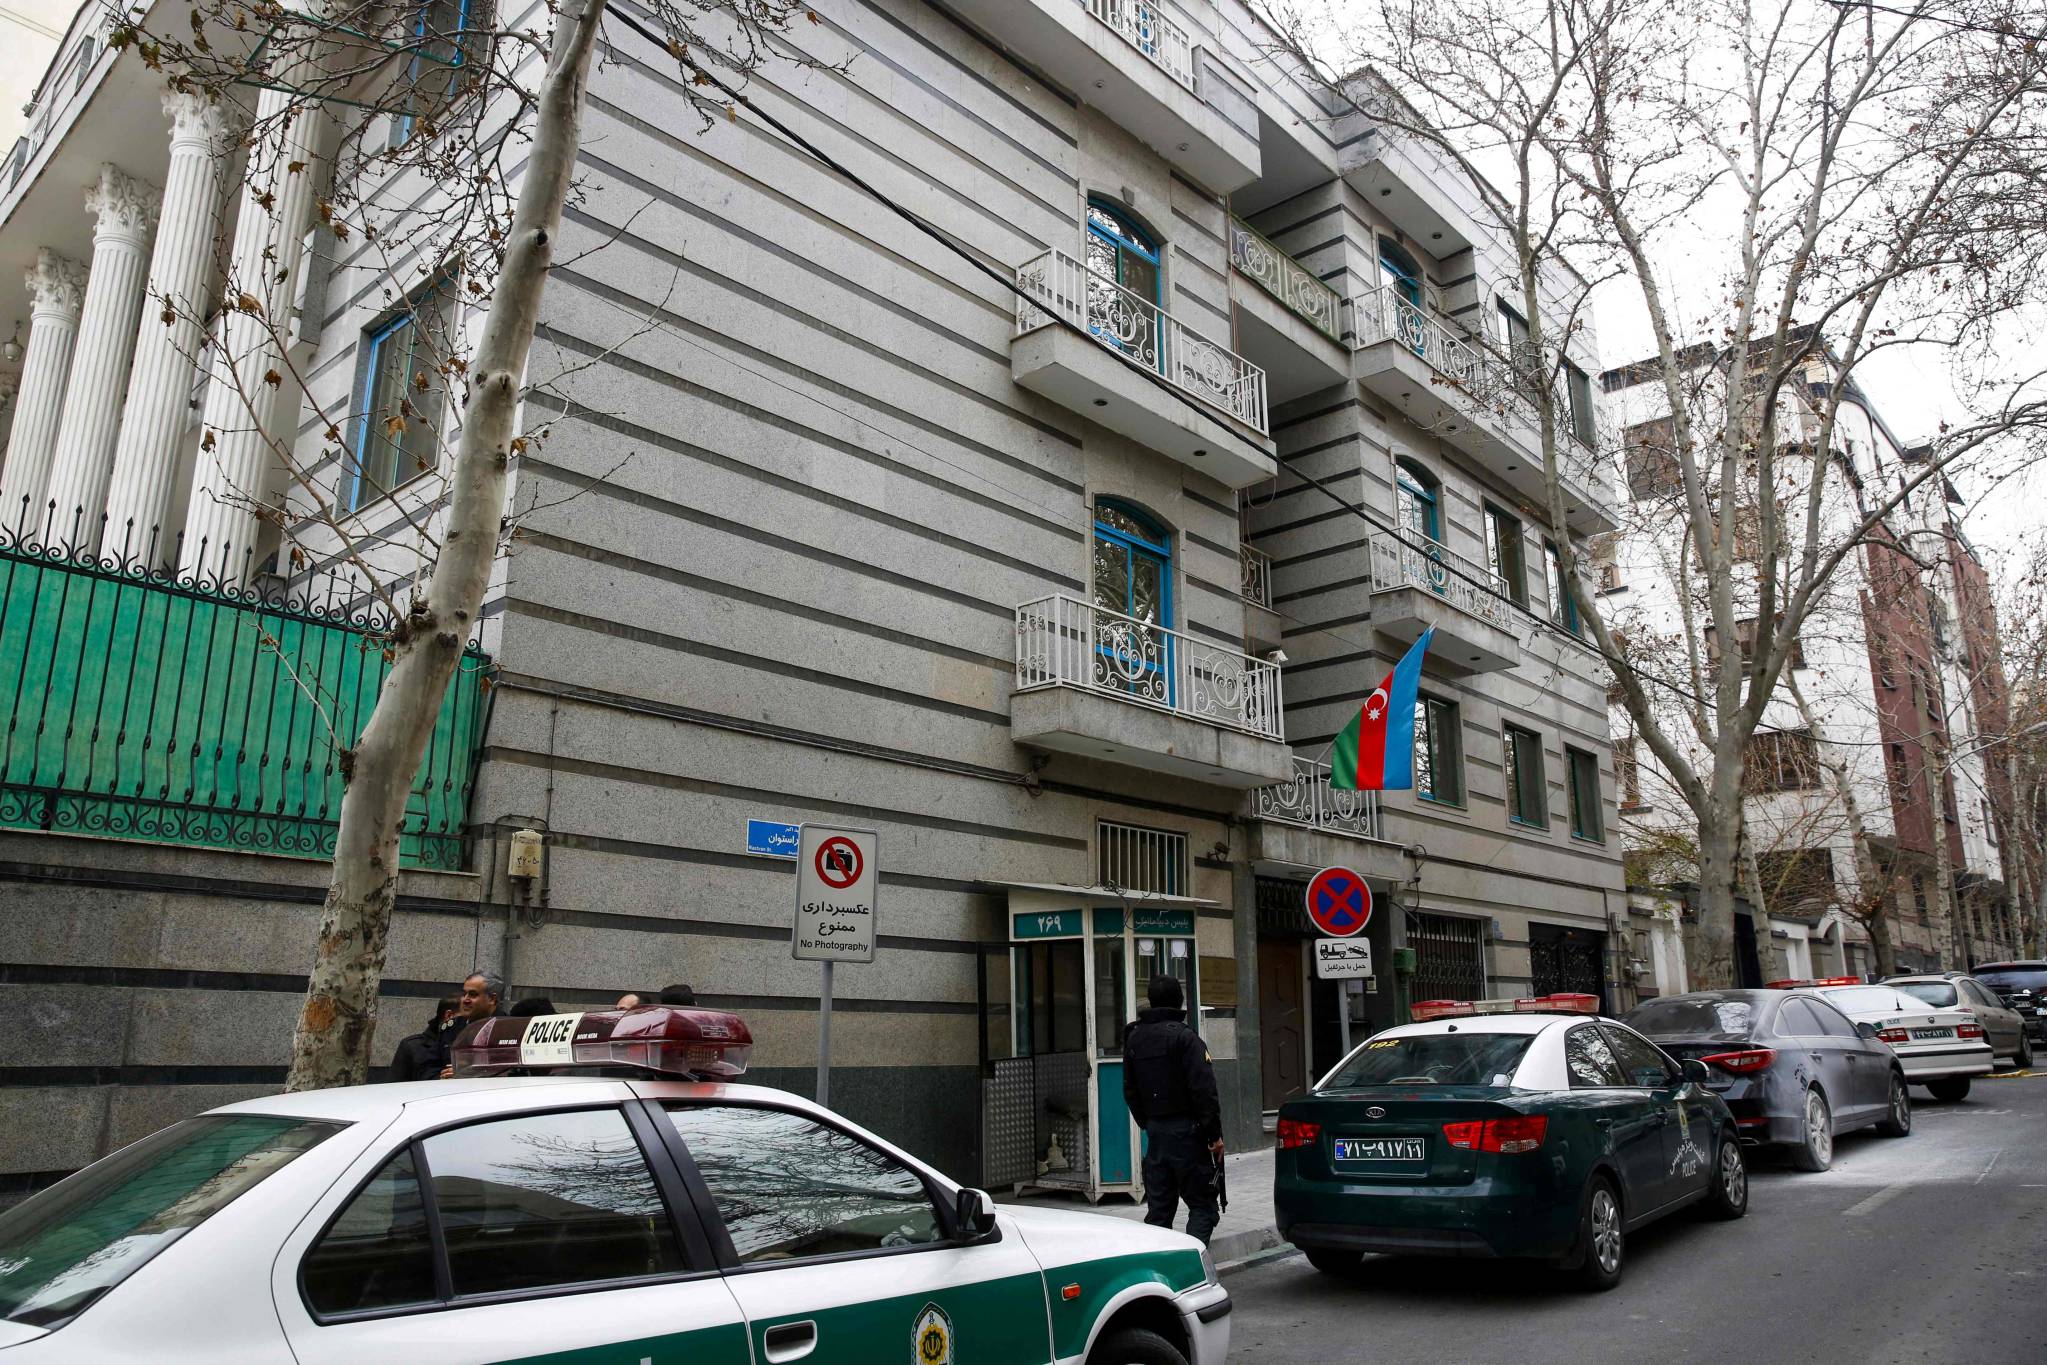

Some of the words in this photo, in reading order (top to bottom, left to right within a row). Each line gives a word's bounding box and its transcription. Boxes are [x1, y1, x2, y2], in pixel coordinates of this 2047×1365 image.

[802, 901, 869, 916] عکسبرداری
[818, 921, 856, 936] ممنوع
[1038, 915, 1061, 933] ۲۶۹
[800, 939, 813, 948] No
[815, 940, 868, 952] Photography
[1353, 963, 1366, 971] حمل
[526, 1020, 574, 1044] POLICE
[1345, 1141, 1360, 1157] ۷۱
[1377, 1141, 1403, 1157] ۹۱۷
[1682, 1160, 1696, 1178] POLICE
